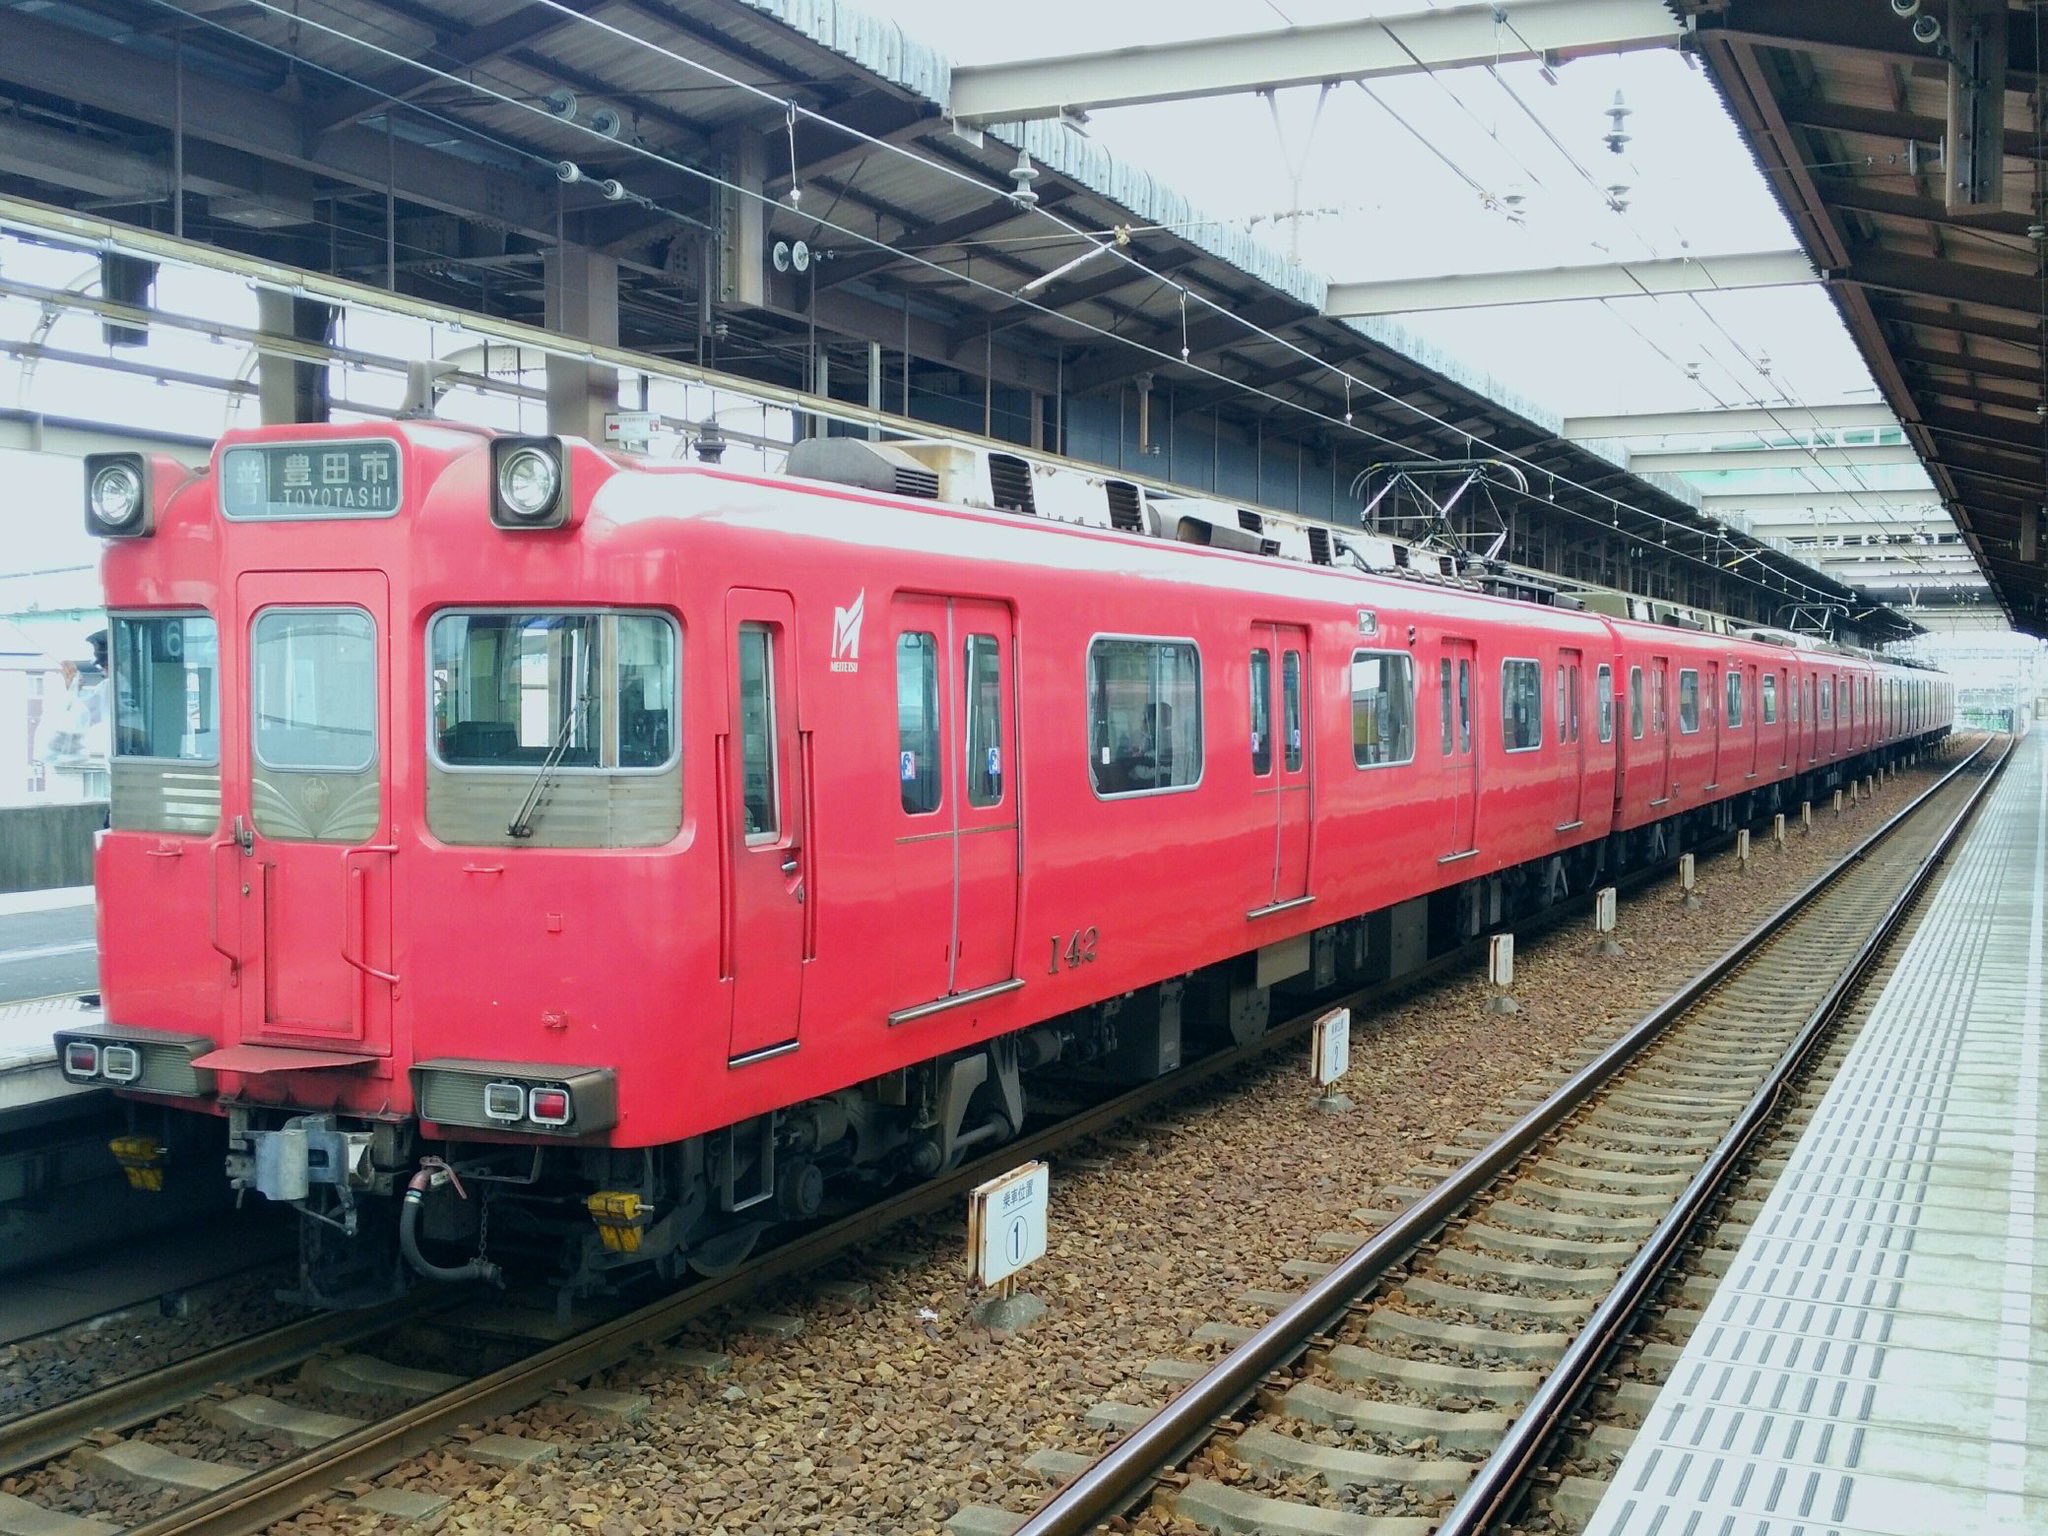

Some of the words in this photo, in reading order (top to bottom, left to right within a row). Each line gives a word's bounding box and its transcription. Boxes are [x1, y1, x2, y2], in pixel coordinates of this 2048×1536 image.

[283, 451, 390, 487] 豊田市
[282, 486, 391, 509] TOYOTASHI
[1048, 926, 1100, 975] 142
[1002, 1178, 1034, 1210] 乗車位置
